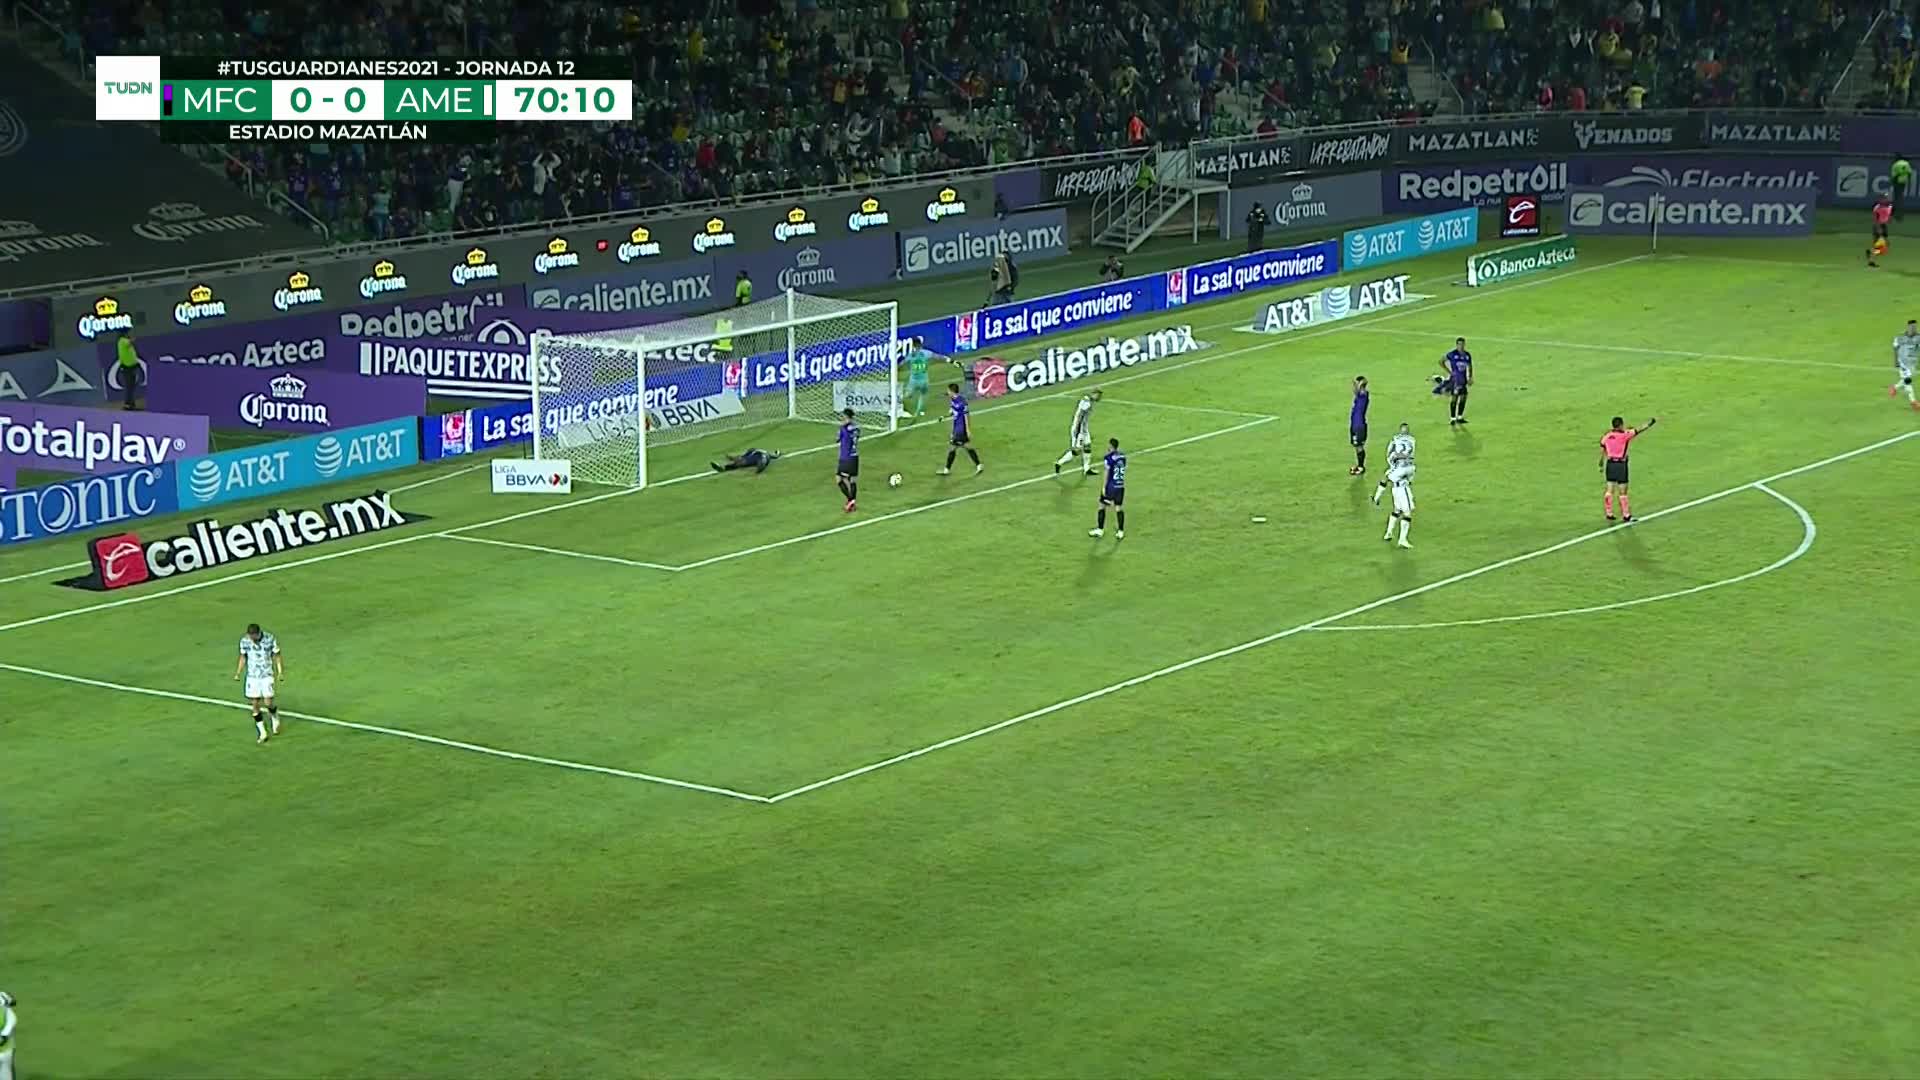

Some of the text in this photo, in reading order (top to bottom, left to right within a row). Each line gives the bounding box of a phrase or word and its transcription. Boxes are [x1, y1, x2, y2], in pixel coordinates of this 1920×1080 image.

[1408, 130, 1524, 151] MAZATLAN
[1711, 124, 1827, 141] MAZATLAN
[1194, 148, 1279, 174] MAZATLAN
[848, 212, 889, 232] Corona
[927, 201, 966, 221] Corona
[1275, 200, 1326, 226] Corona
[1607, 196, 1806, 225] caliente.mx
[693, 232, 735, 252] Corona
[774, 222, 816, 242] Corona
[1368, 230, 1405, 257] AT&T
[1436, 217, 1470, 244] AT&T
[617, 242, 660, 262] Corona
[932, 225, 1064, 265] caliente.mx
[452, 263, 498, 285] Corona
[534, 252, 579, 273] Corona
[1193, 253, 1324, 295] La sal que conviene
[1499, 247, 1575, 276] Banco Azteca
[360, 276, 407, 298] Corona
[777, 266, 836, 291] Corona
[274, 287, 322, 311] Corona
[564, 274, 712, 312] caliente.mx
[1358, 275, 1411, 310] AT&T
[78, 314, 133, 338] Corona
[174, 301, 226, 325] Corona
[984, 292, 1133, 340] La sal que conviene
[1264, 295, 1318, 331] AT&T
[243, 338, 325, 368] Azteca
[1007, 325, 1199, 391] caliente.mx
[756, 363, 776, 387] La
[811, 351, 843, 381] que
[240, 393, 329, 427] Corona
[483, 385, 678, 442] La sa que convene
[663, 399, 720, 426] BBVA
[346, 429, 406, 467] AT&T
[225, 451, 290, 491] AT&T
[495, 465, 517, 474] LIGA
[506, 474, 545, 487] BBVA
[0, 468, 156, 540] TONIC
[146, 492, 407, 577] caliente.mx
